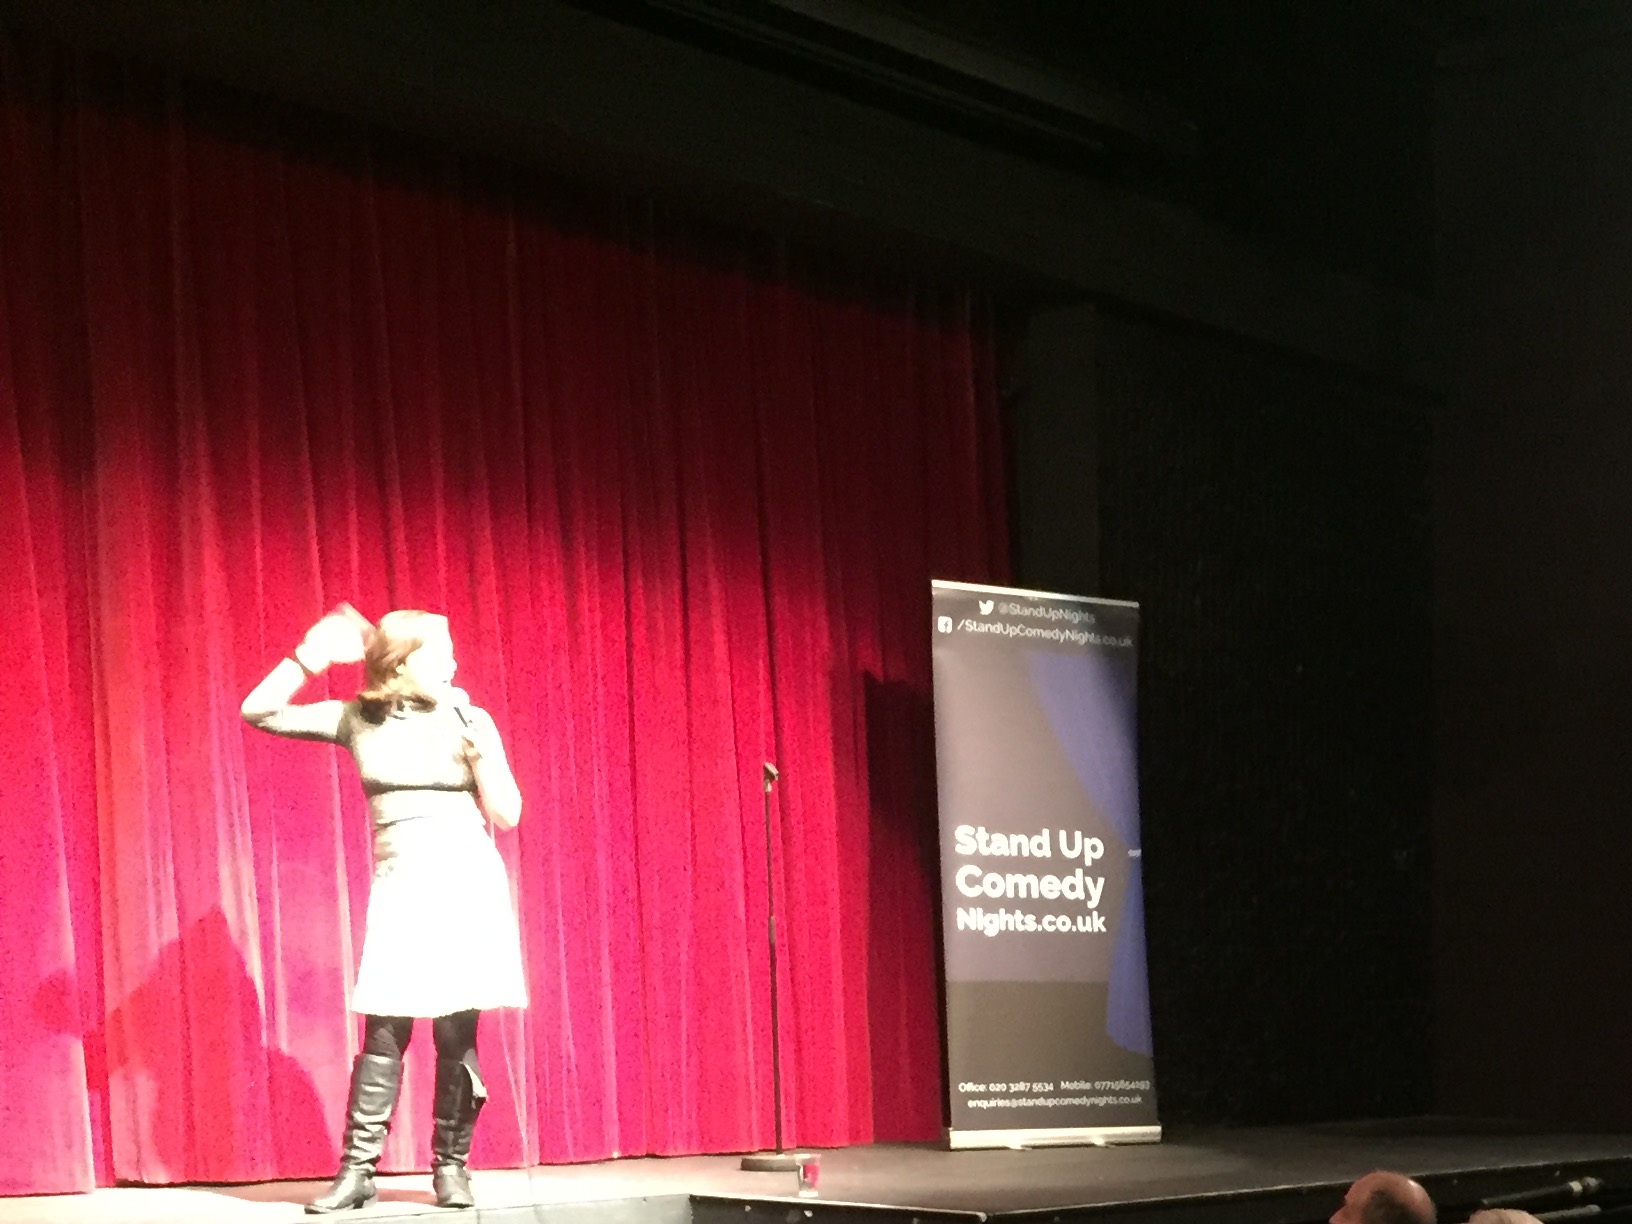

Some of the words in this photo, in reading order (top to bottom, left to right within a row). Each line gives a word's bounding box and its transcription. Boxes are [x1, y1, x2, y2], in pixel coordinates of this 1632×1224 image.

[954, 824, 1051, 857] Stand
[1059, 829, 1105, 866] Up
[955, 864, 1105, 909] Comedy
[956, 907, 1107, 938] Nights.co.uk
